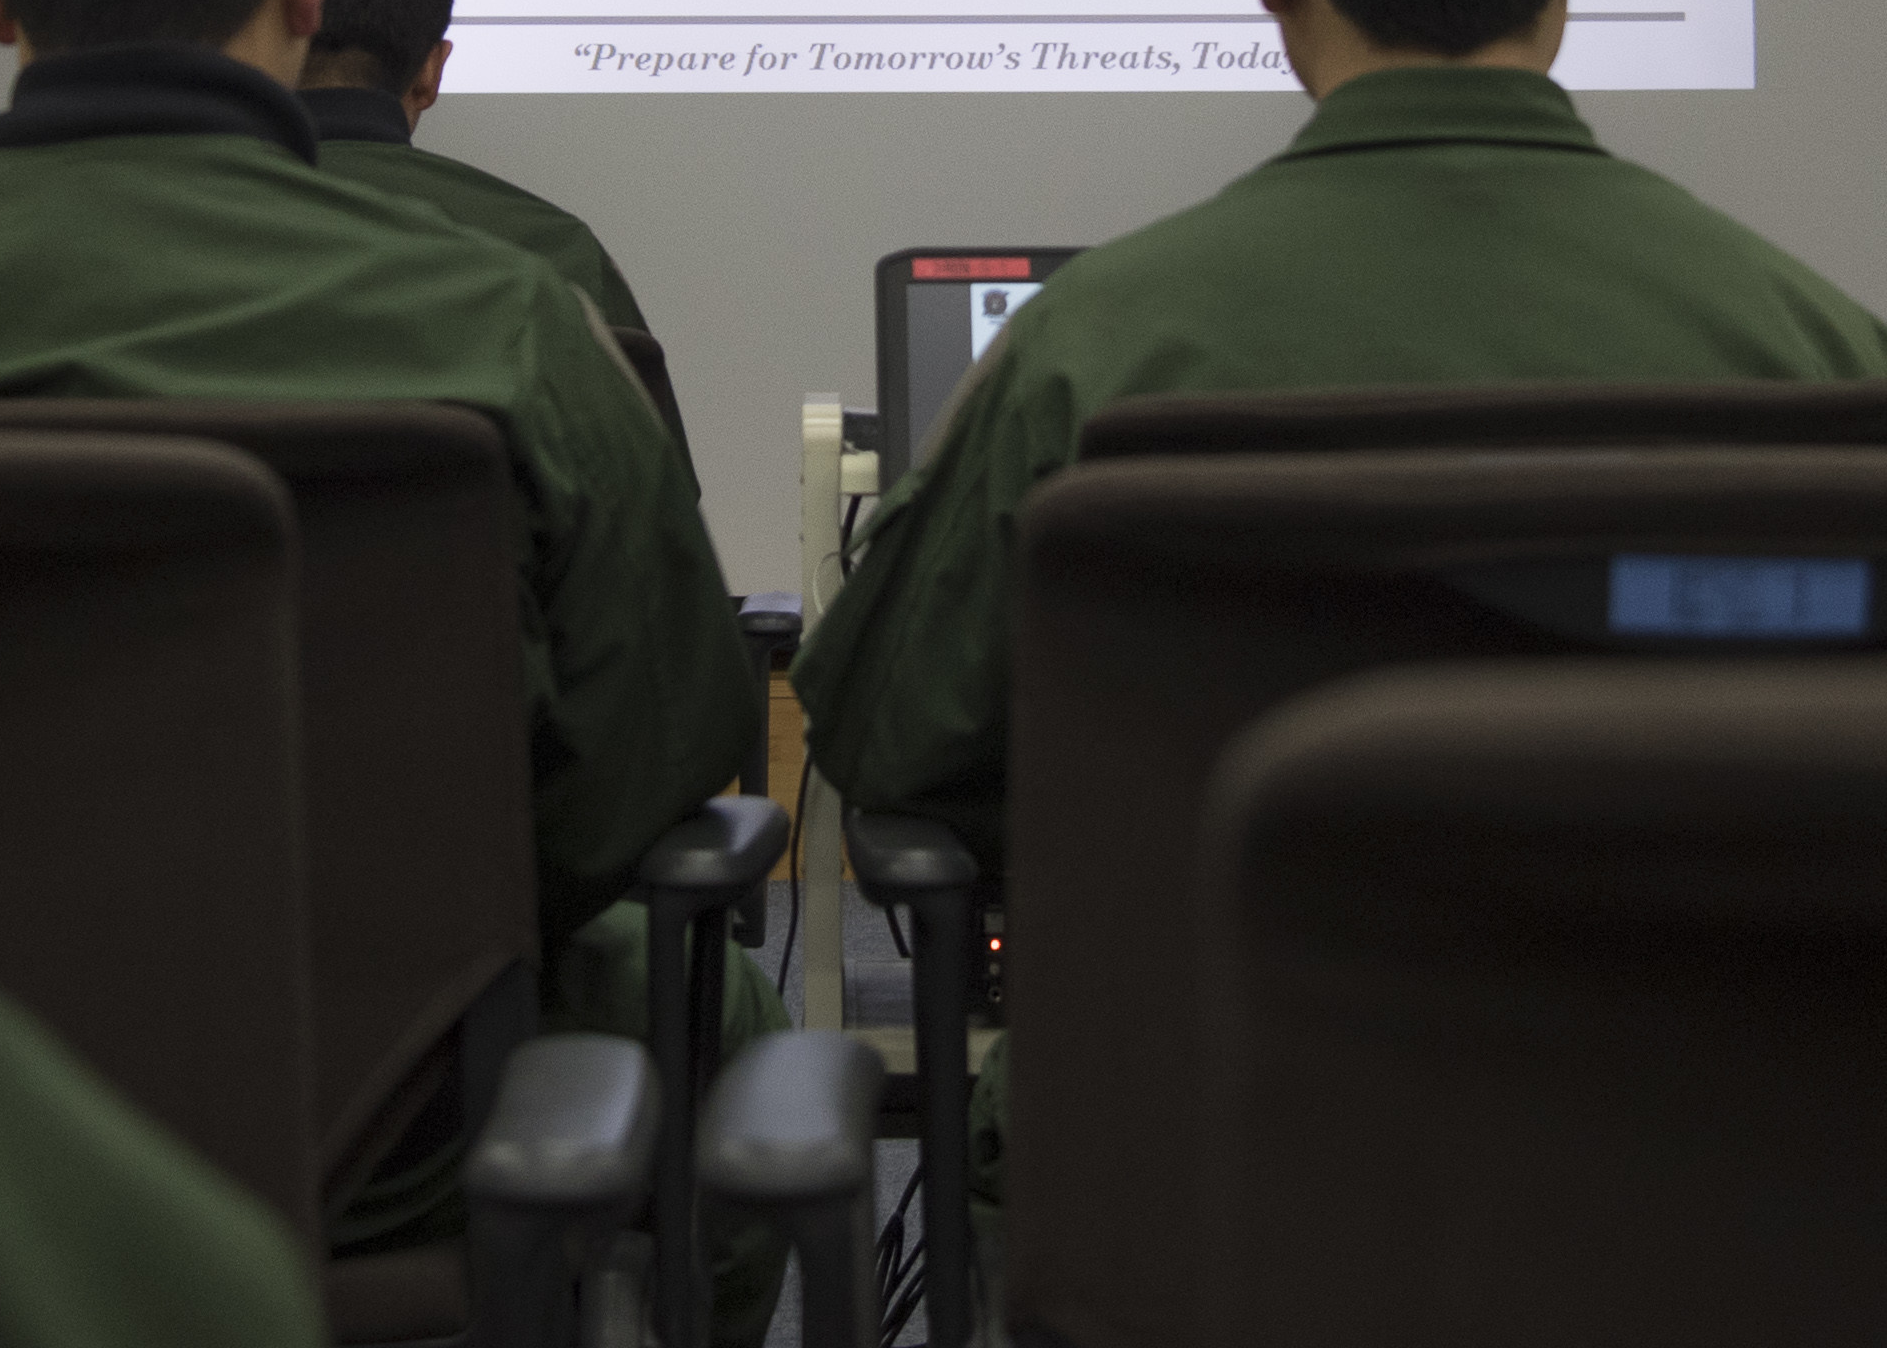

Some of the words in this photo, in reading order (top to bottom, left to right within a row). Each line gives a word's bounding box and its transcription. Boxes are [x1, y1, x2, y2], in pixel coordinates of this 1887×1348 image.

[574, 43, 736, 77] “Prepare
[742, 43, 798, 77] for
[809, 42, 1021, 71] Tomorrow’s
[1031, 42, 1182, 76] Threats,
